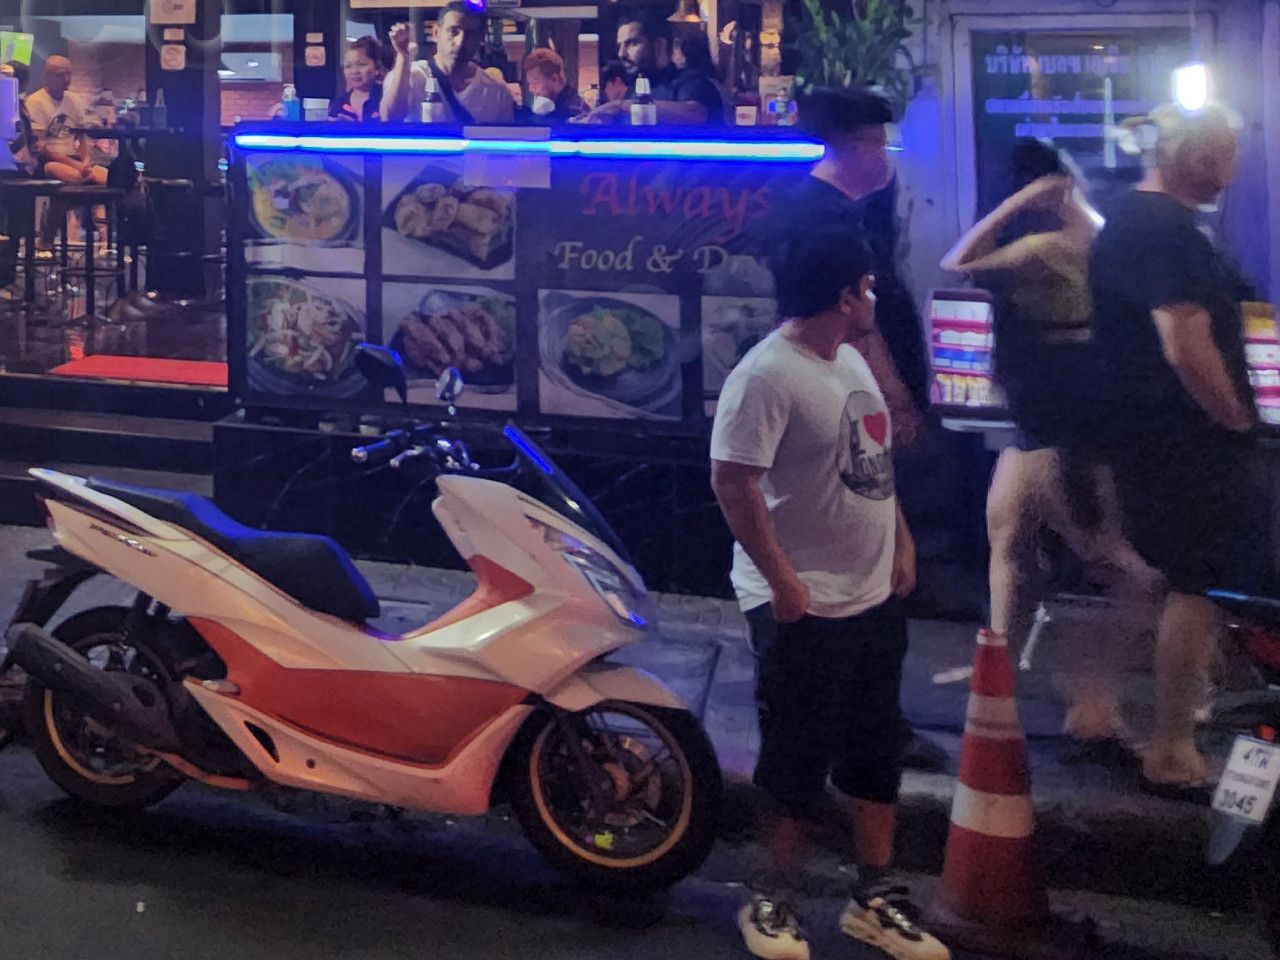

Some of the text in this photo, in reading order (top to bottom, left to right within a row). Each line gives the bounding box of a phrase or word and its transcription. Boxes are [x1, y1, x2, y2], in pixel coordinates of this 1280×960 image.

[579, 167, 770, 244] Always
[553, 236, 643, 272] Food
[645, 244, 682, 273] &
